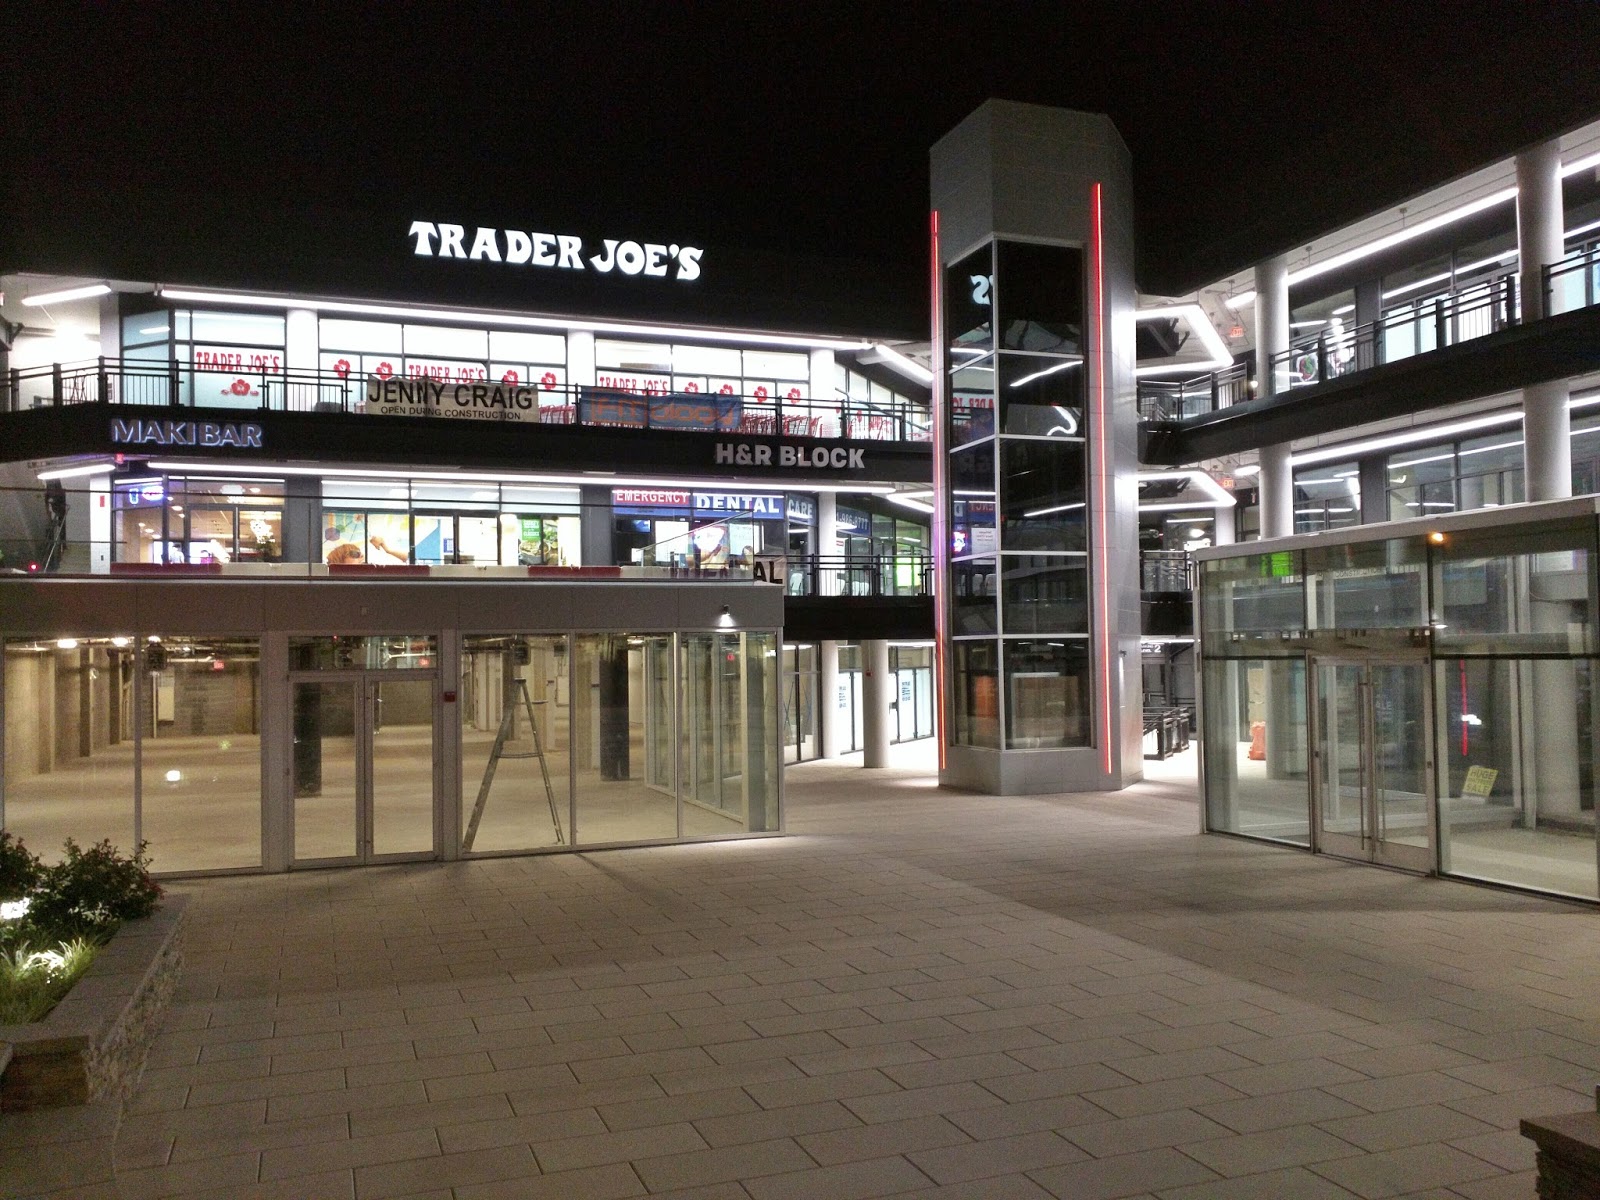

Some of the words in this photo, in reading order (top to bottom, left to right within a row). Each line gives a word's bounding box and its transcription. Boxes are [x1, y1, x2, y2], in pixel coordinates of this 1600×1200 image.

[408, 220, 585, 270] TRADER
[590, 238, 704, 281] JOE'S
[196, 351, 242, 371] TRADER
[247, 354, 280, 373] JOE'S
[409, 364, 450, 383] TRADER
[455, 367, 485, 384] JOE'S
[369, 379, 446, 406] JENNY
[454, 383, 533, 410] CRAIG
[599, 376, 638, 395] TRADER
[641, 379, 668, 396] JOE'S
[381, 405, 406, 415] OPEN
[409, 406, 442, 417] DURING
[444, 409, 521, 420] CONSTRUCTION
[111, 418, 196, 445] MAKI
[200, 421, 263, 447] BAR
[715, 443, 773, 466] H&R
[779, 445, 866, 469] BLOCK
[616, 489, 688, 503] EMERGENCY
[695, 495, 780, 513] DENTAL
[788, 498, 813, 518] CARE
[1154, 644, 1161, 653] 2
